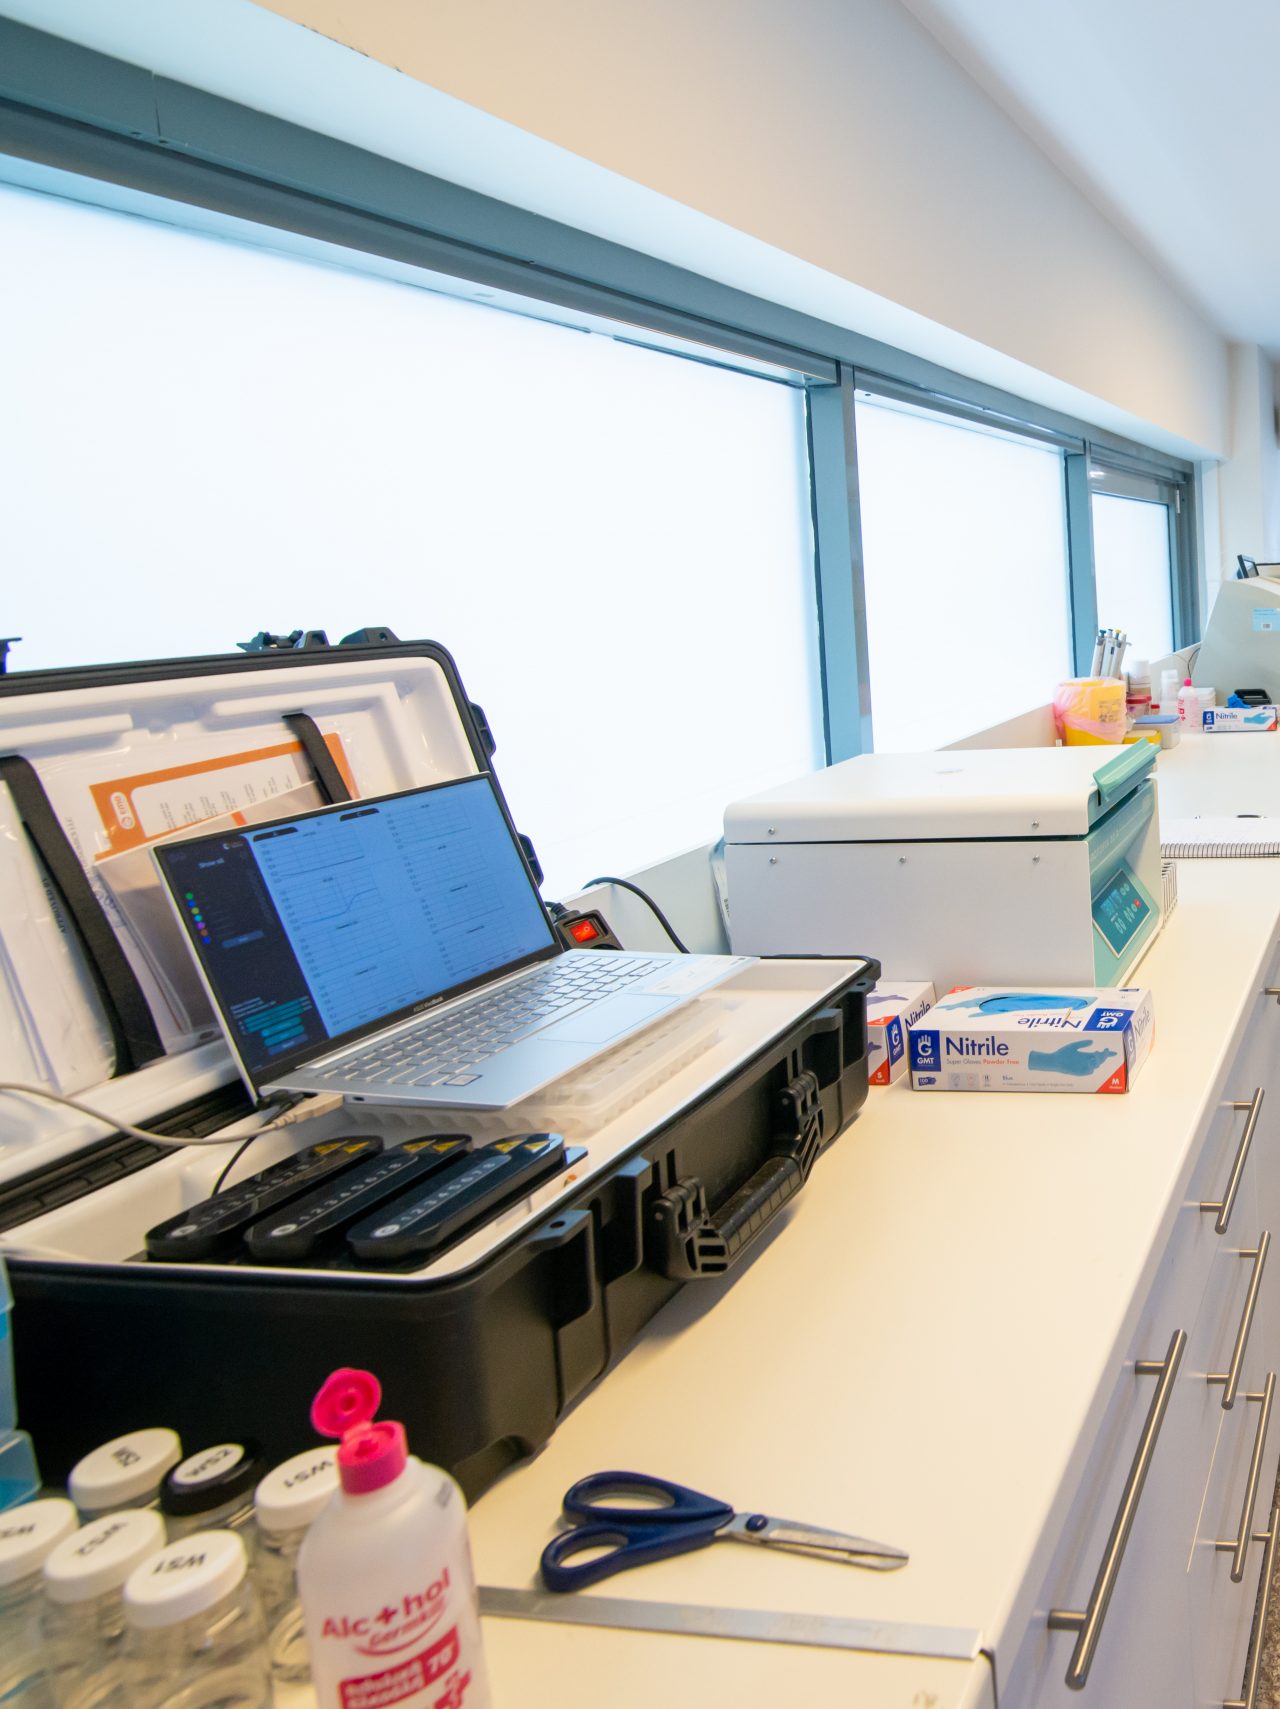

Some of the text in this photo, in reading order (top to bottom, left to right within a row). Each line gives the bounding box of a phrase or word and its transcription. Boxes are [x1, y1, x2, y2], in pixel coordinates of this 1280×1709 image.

[1215, 712, 1238, 720] Nitrile
[904, 1000, 931, 1034] Nitrile
[1017, 1017, 1081, 1028] Nitrile
[946, 1035, 1009, 1056] Nitrile
[283, 1459, 334, 1489] WS1
[152, 1552, 207, 1576] WS1
